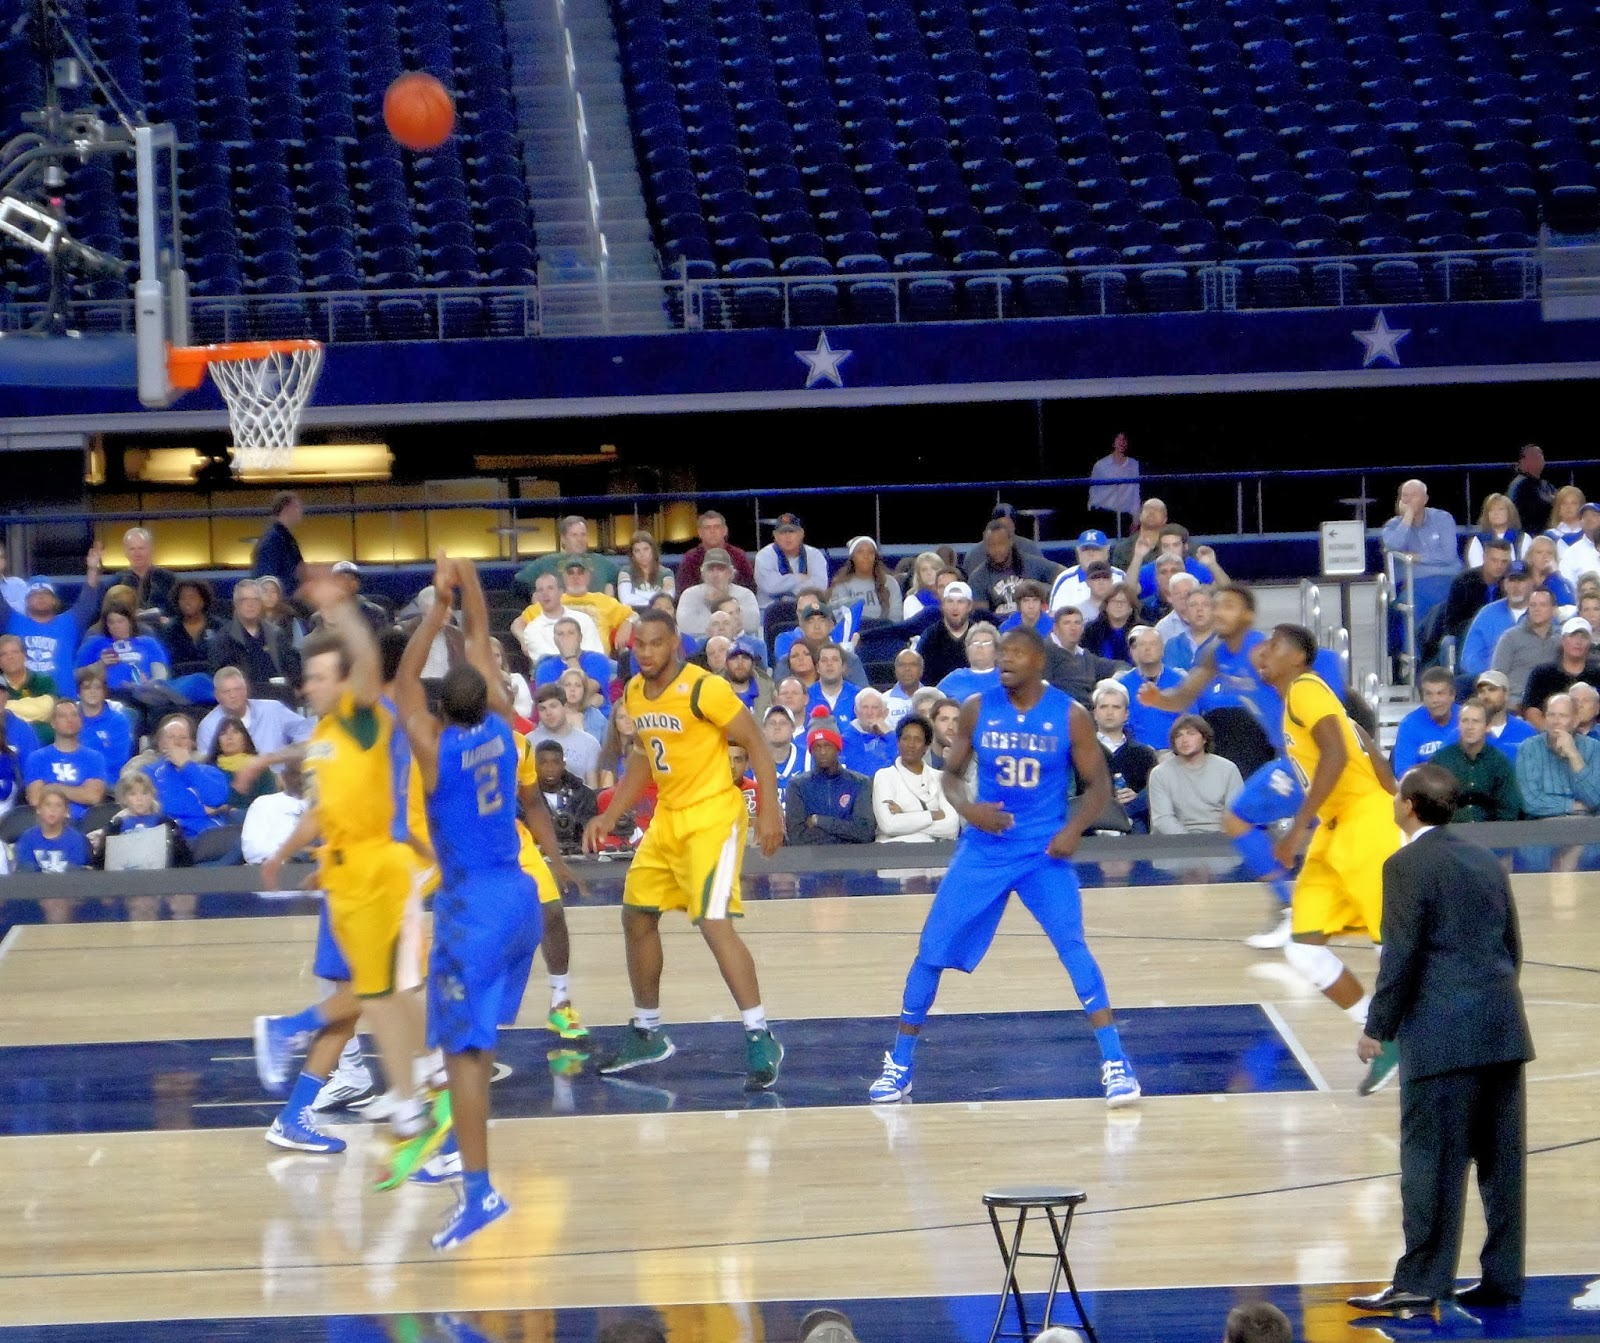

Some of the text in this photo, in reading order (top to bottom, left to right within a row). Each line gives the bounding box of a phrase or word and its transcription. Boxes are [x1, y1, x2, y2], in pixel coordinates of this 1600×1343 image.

[1086, 532, 1097, 541] K
[650, 736, 672, 774] 2
[995, 755, 1041, 789] 30
[474, 763, 503, 816] 2
